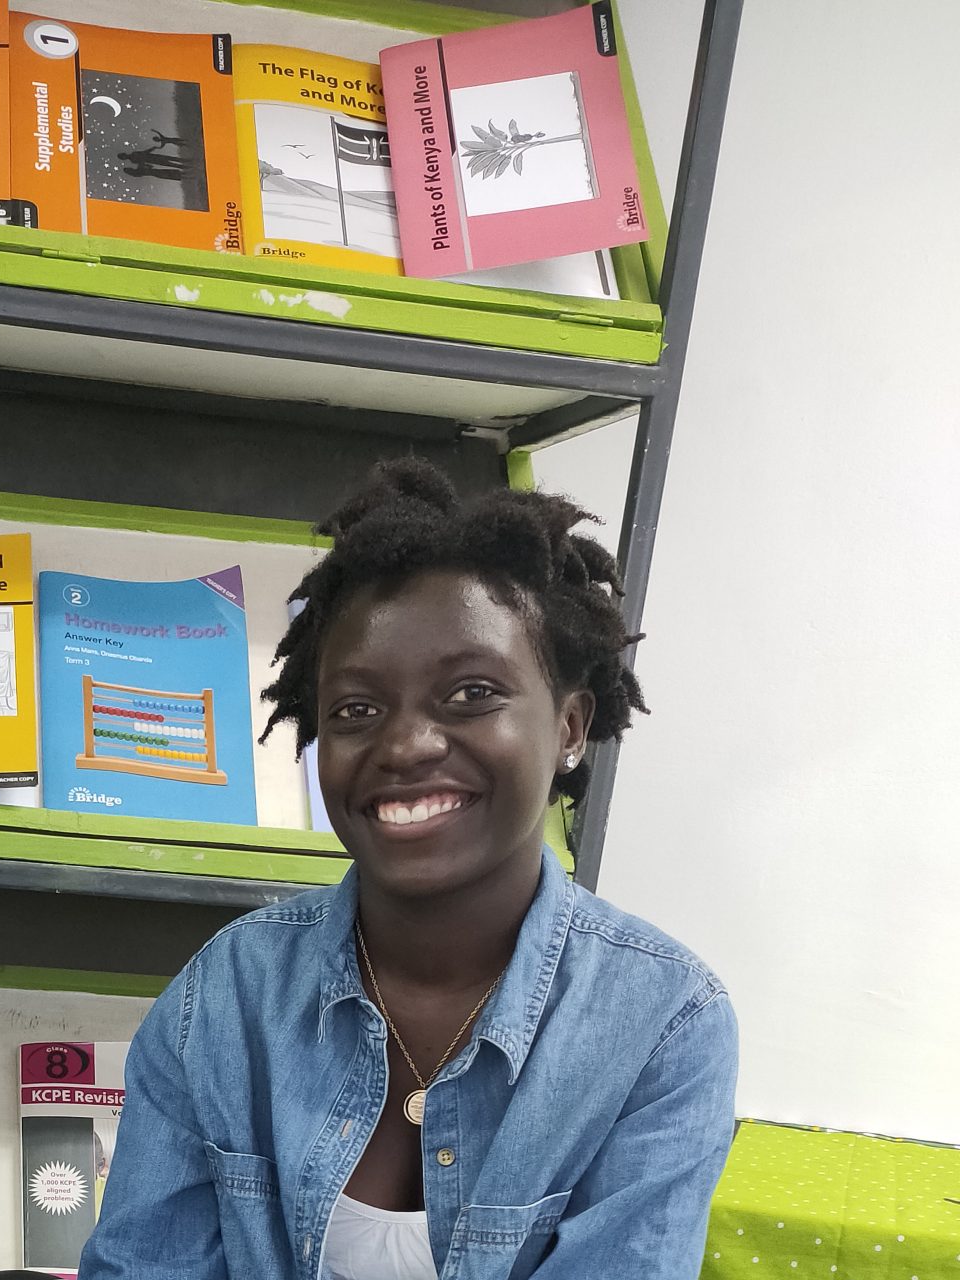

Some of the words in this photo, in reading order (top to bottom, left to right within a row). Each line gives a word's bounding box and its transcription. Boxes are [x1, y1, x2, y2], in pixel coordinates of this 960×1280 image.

[40, 34, 70, 44] 1
[258, 62, 295, 77] The
[299, 67, 339, 89] Flag
[343, 79, 362, 91] of
[412, 65, 431, 104] More
[300, 88, 335, 103] and
[340, 94, 386, 115] More
[32, 81, 54, 172] Supplemental
[57, 105, 75, 154] Studies
[414, 106, 435, 136] and
[424, 138, 442, 184] Kenya
[425, 186, 444, 200] of
[622, 186, 640, 226] Bridge
[223, 201, 242, 250] Bridge
[431, 203, 451, 250] Plants
[262, 247, 306, 259] Bridge
[71, 592, 82, 605] 2
[64, 611, 169, 639] Homework
[175, 623, 229, 640] Book
[64, 632, 103, 644] Answer
[105, 637, 124, 649] Key
[65, 656, 83, 665] Term
[75, 791, 122, 807] Bridge
[46, 1052, 69, 1079] 8
[31, 1089, 71, 1102] KCPE
